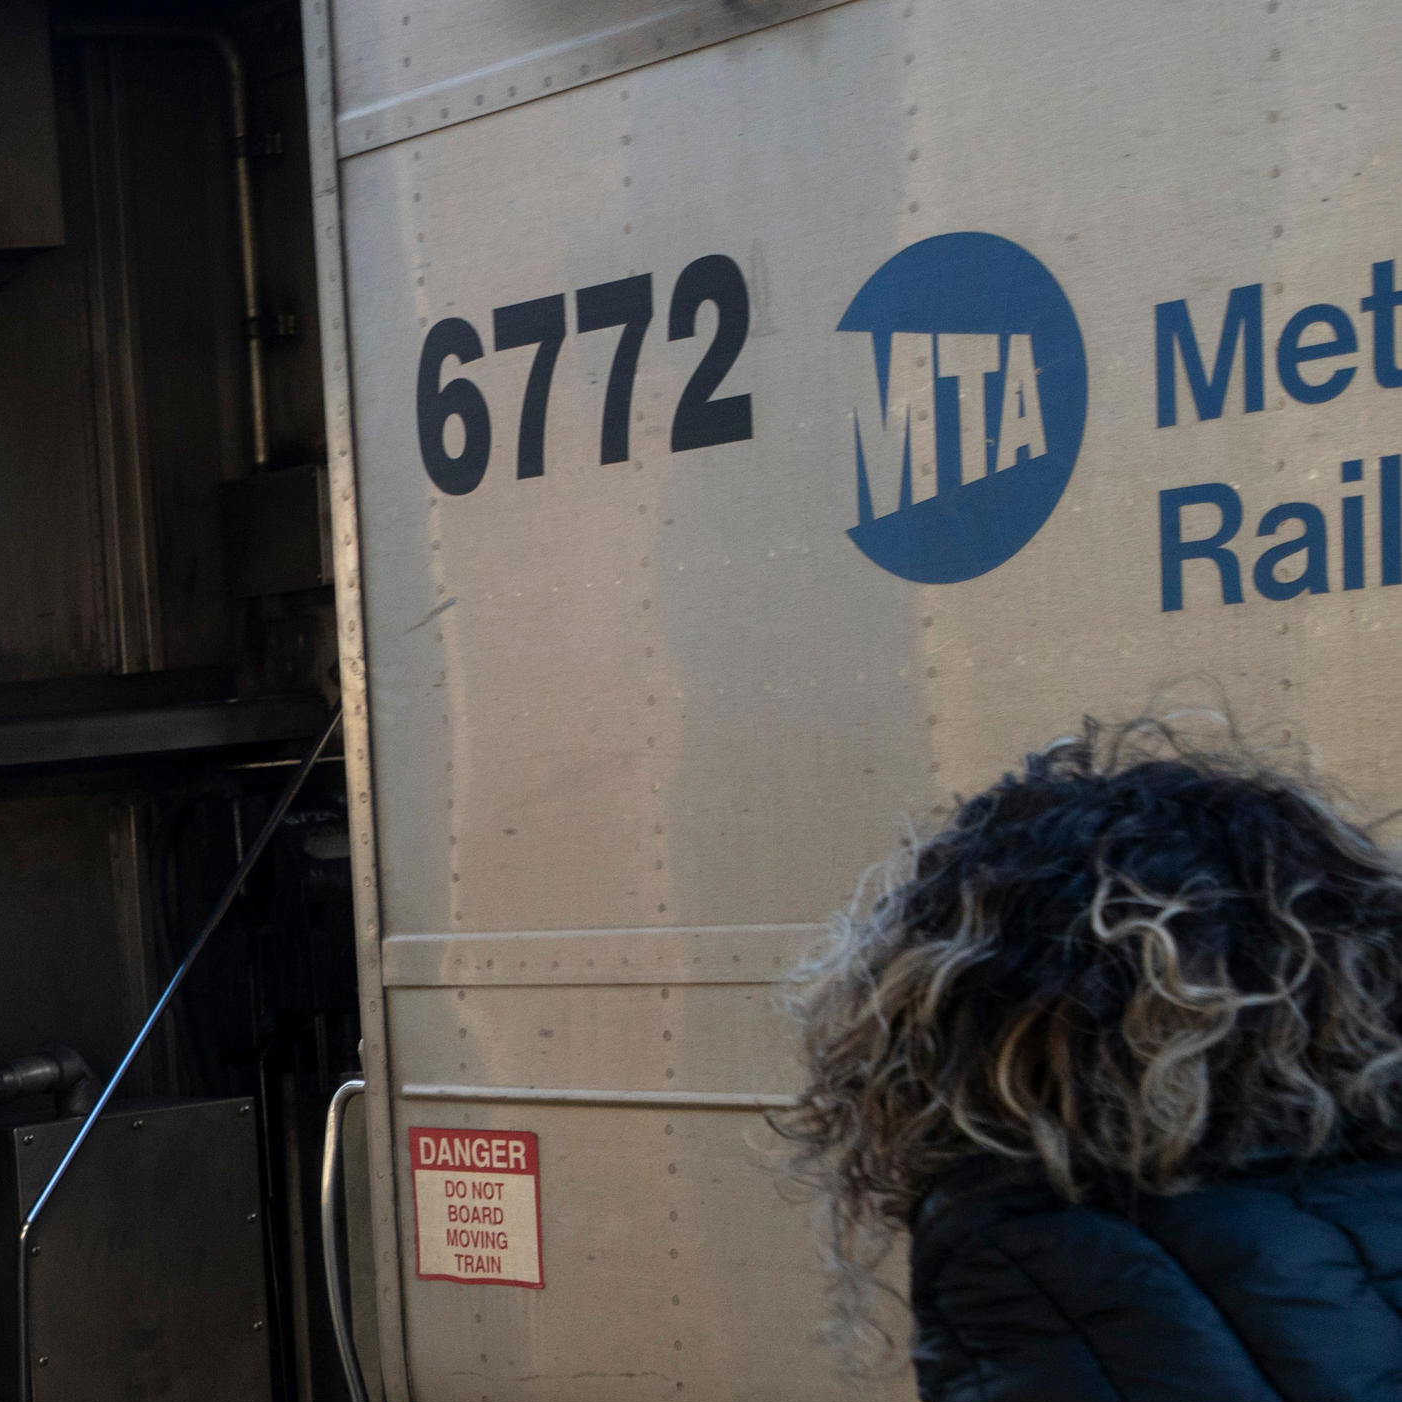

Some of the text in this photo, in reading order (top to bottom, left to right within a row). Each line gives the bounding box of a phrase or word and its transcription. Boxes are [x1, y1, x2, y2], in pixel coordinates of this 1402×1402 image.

[1154, 259, 1402, 429] Met
[415, 254, 753, 498] 6772
[836, 330, 1048, 530] MTA
[1160, 454, 1402, 613] Rail
[419, 1136, 528, 1170] DANGER
[444, 1180, 504, 1200] DO NOT
[447, 1205, 505, 1225] BOARD
[446, 1229, 509, 1250] MOVING
[454, 1253, 502, 1274] TRAIN
